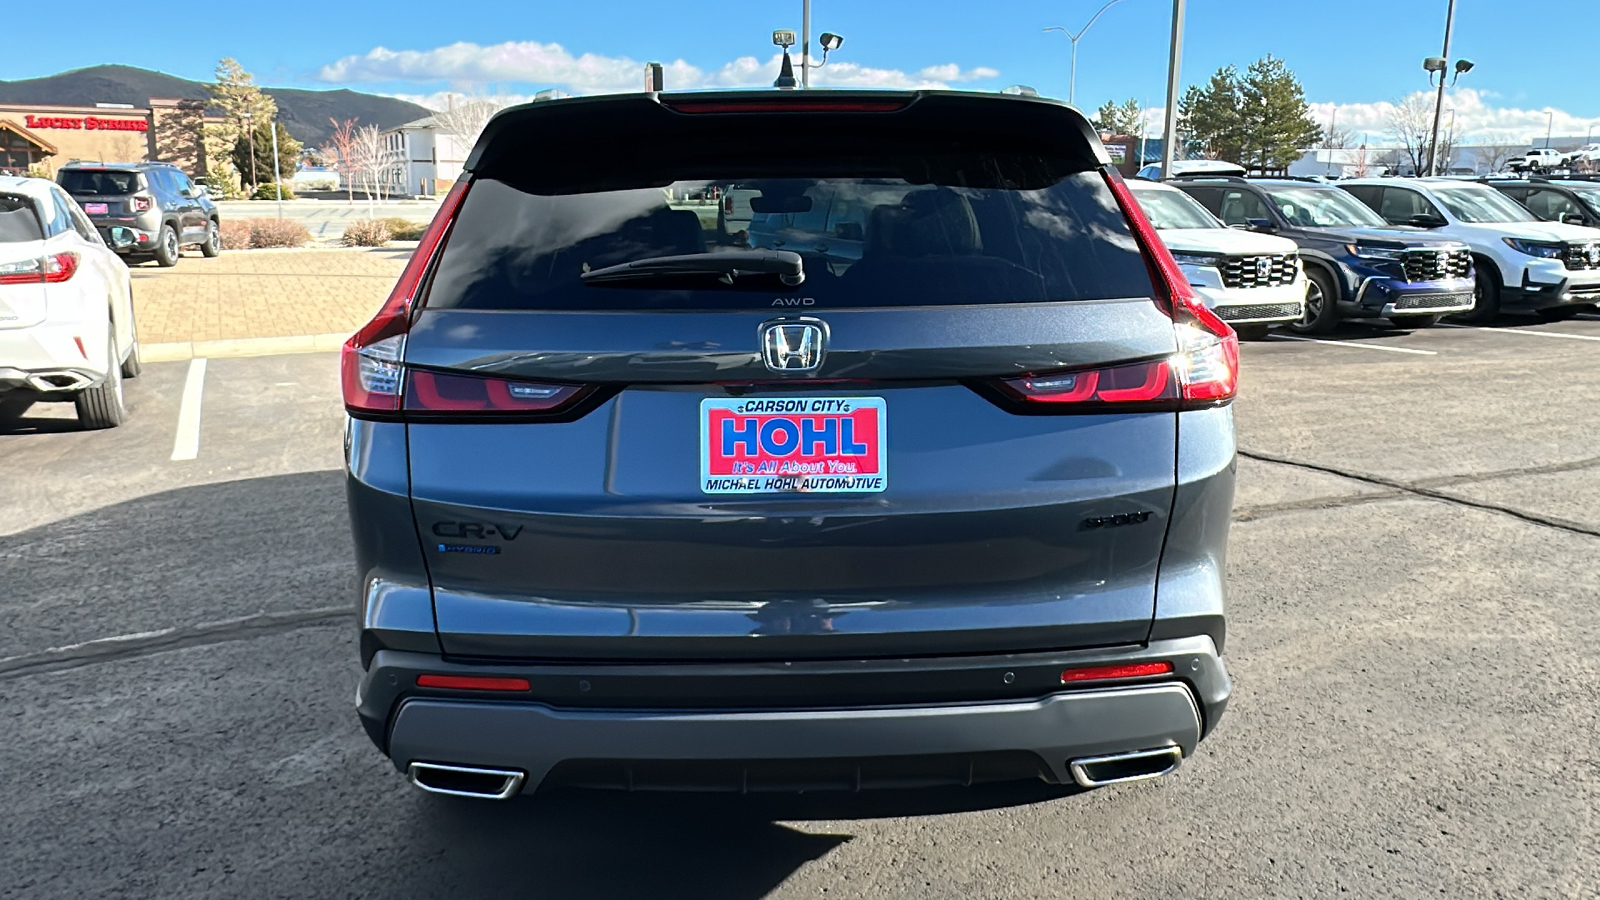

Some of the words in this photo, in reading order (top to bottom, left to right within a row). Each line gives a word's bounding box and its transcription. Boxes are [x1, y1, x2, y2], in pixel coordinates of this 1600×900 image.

[771, 298, 815, 306] AWD
[745, 400, 807, 412] CARSON
[811, 400, 845, 412] CITY
[721, 418, 868, 456] HOHL
[732, 461, 754, 474] It's
[757, 460, 778, 474] All
[778, 460, 824, 474] About
[705, 479, 761, 490] MICHAEL
[764, 478, 798, 490] HOHL
[801, 477, 882, 489] AUTOMOTIVE
[432, 521, 523, 541] CR-V
